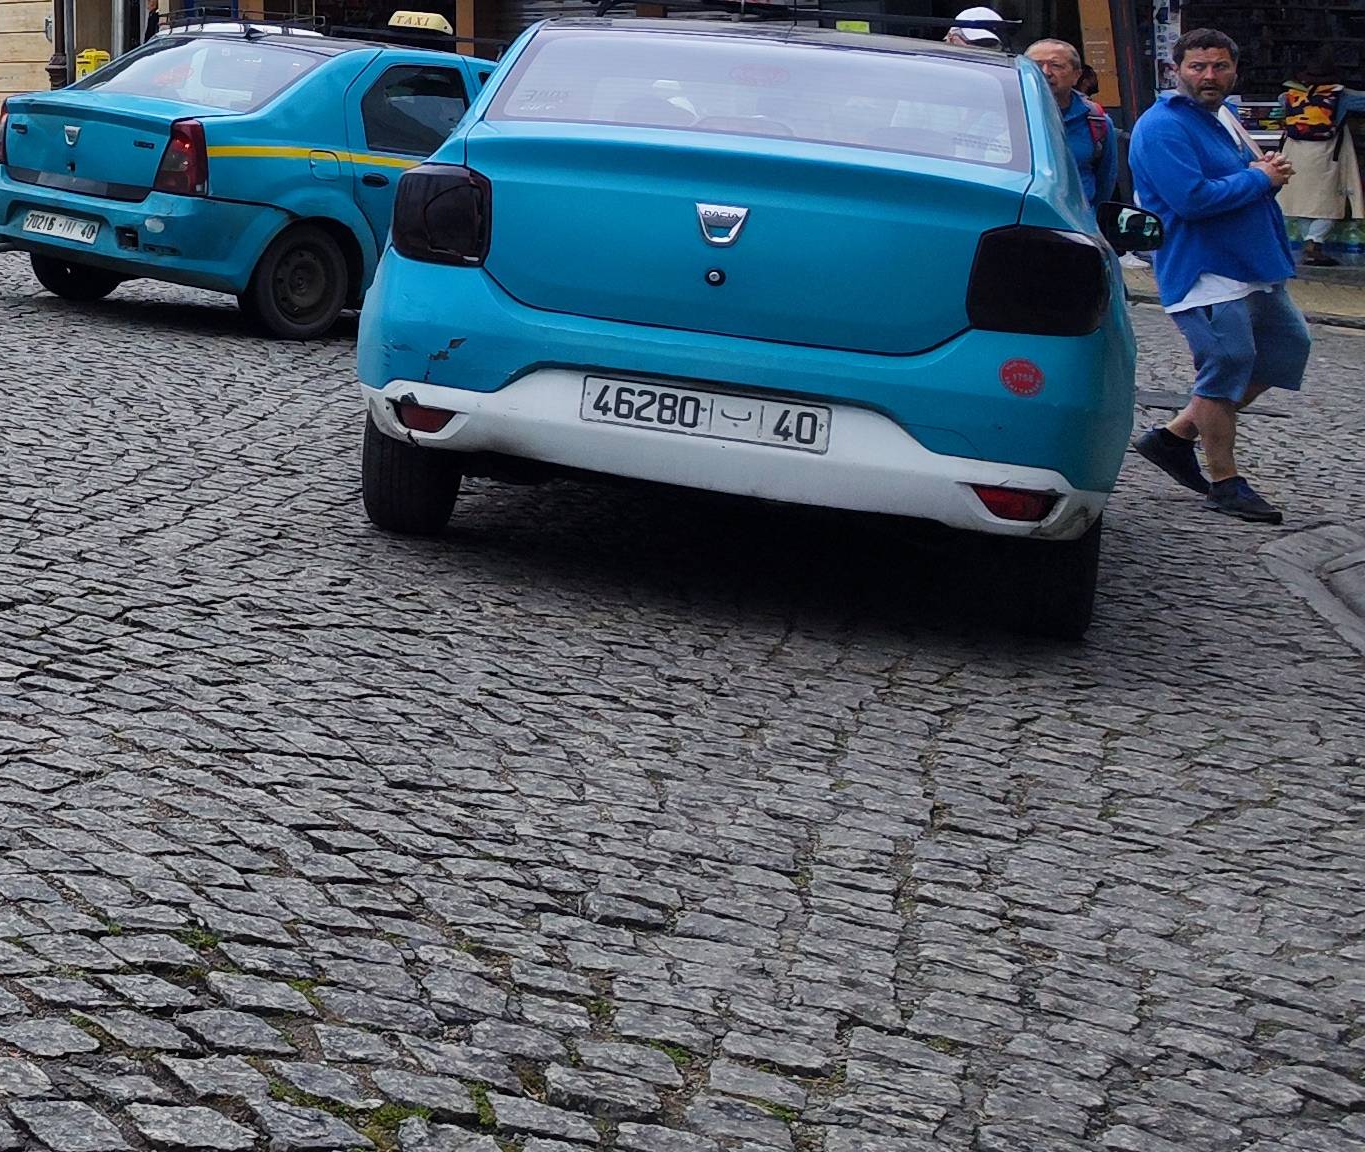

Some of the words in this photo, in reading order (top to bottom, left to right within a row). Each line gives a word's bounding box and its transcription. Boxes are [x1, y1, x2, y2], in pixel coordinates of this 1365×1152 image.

[396, 15, 430, 26] TAXI
[80, 223, 96, 240] 40
[592, 385, 701, 429] 46280
[721, 408, 752, 428] ب
[773, 409, 818, 445] 40
